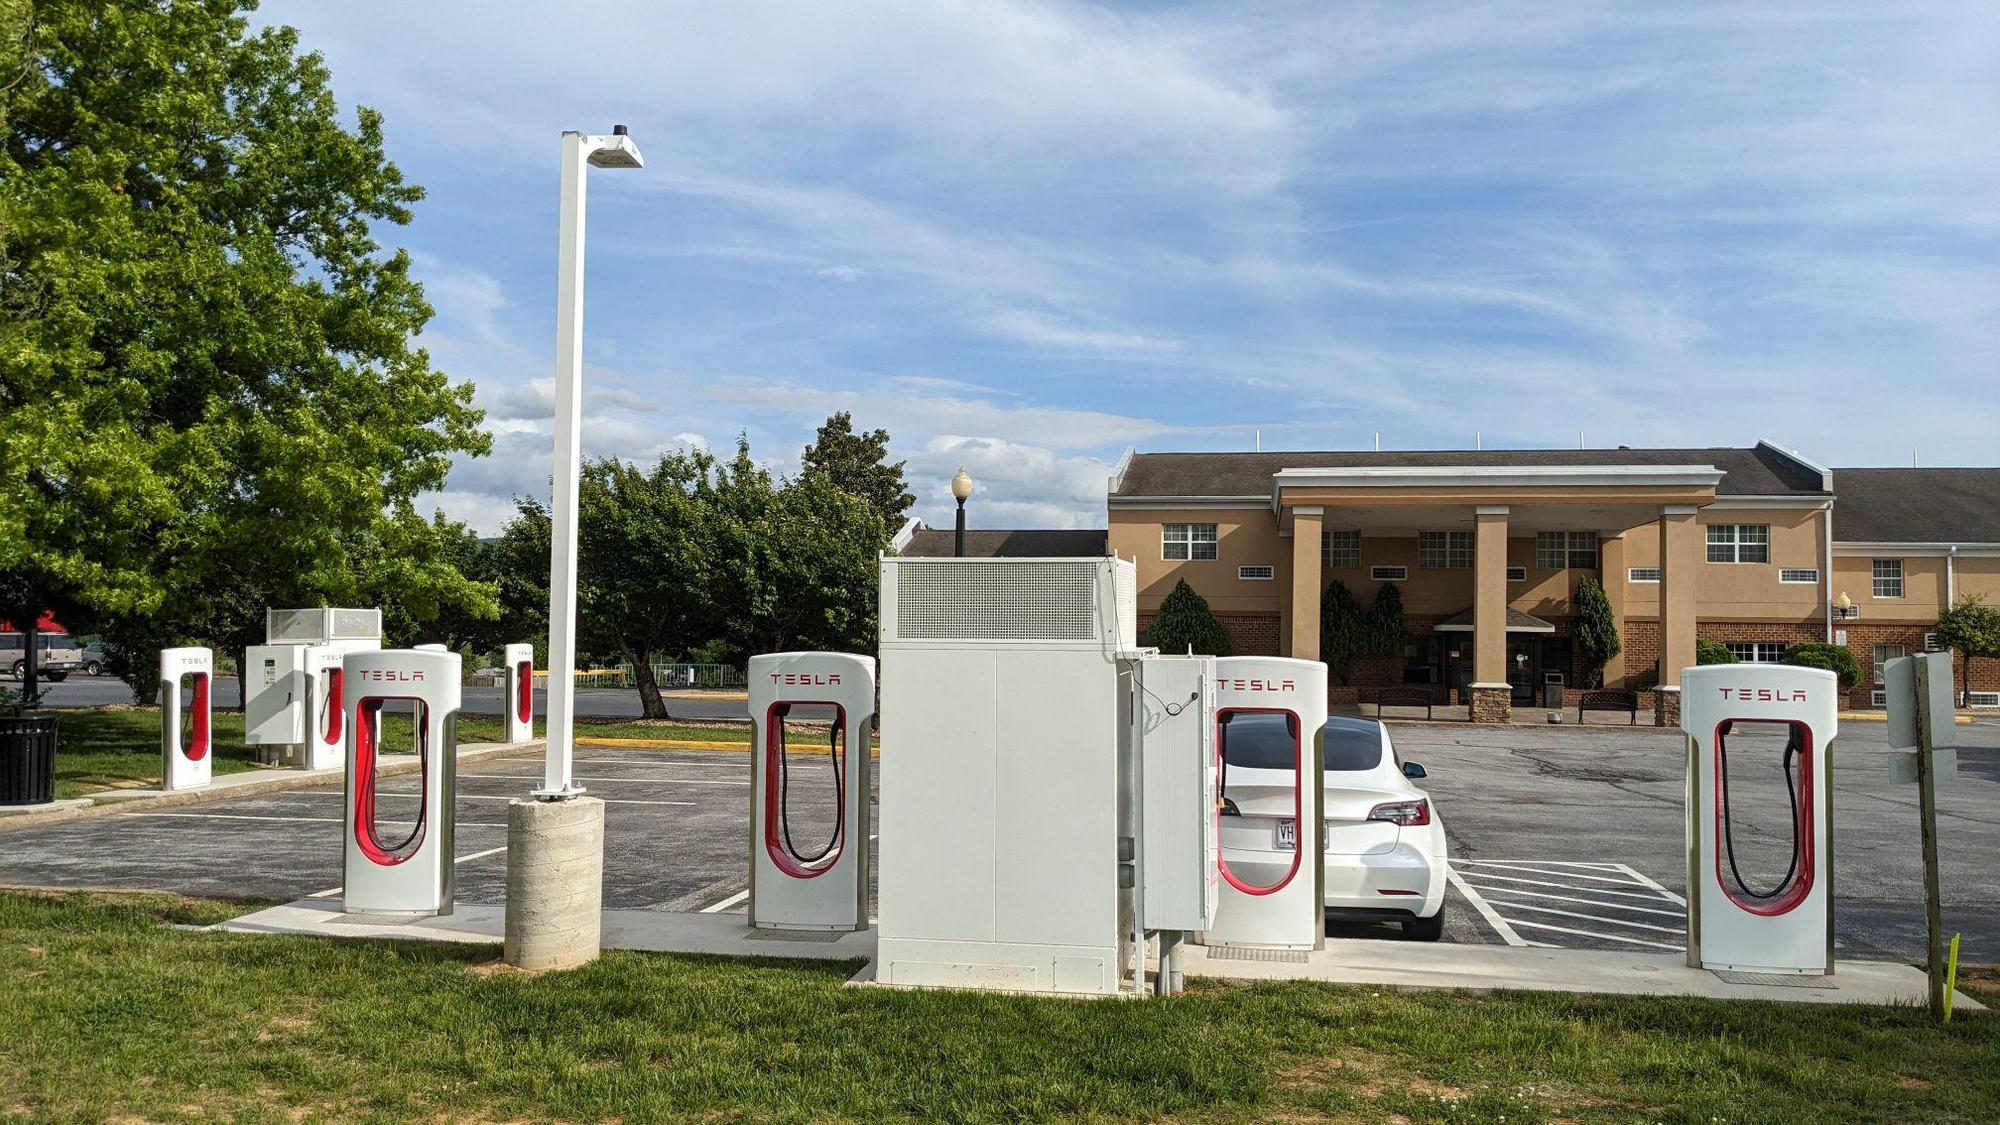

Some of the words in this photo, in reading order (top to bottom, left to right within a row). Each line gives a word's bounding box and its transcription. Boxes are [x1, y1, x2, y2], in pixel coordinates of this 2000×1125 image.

[360, 670, 424, 681] TESLA
[770, 674, 841, 685] TESLA
[1217, 679, 1295, 691] TESLA
[1719, 688, 1806, 702] TESLA
